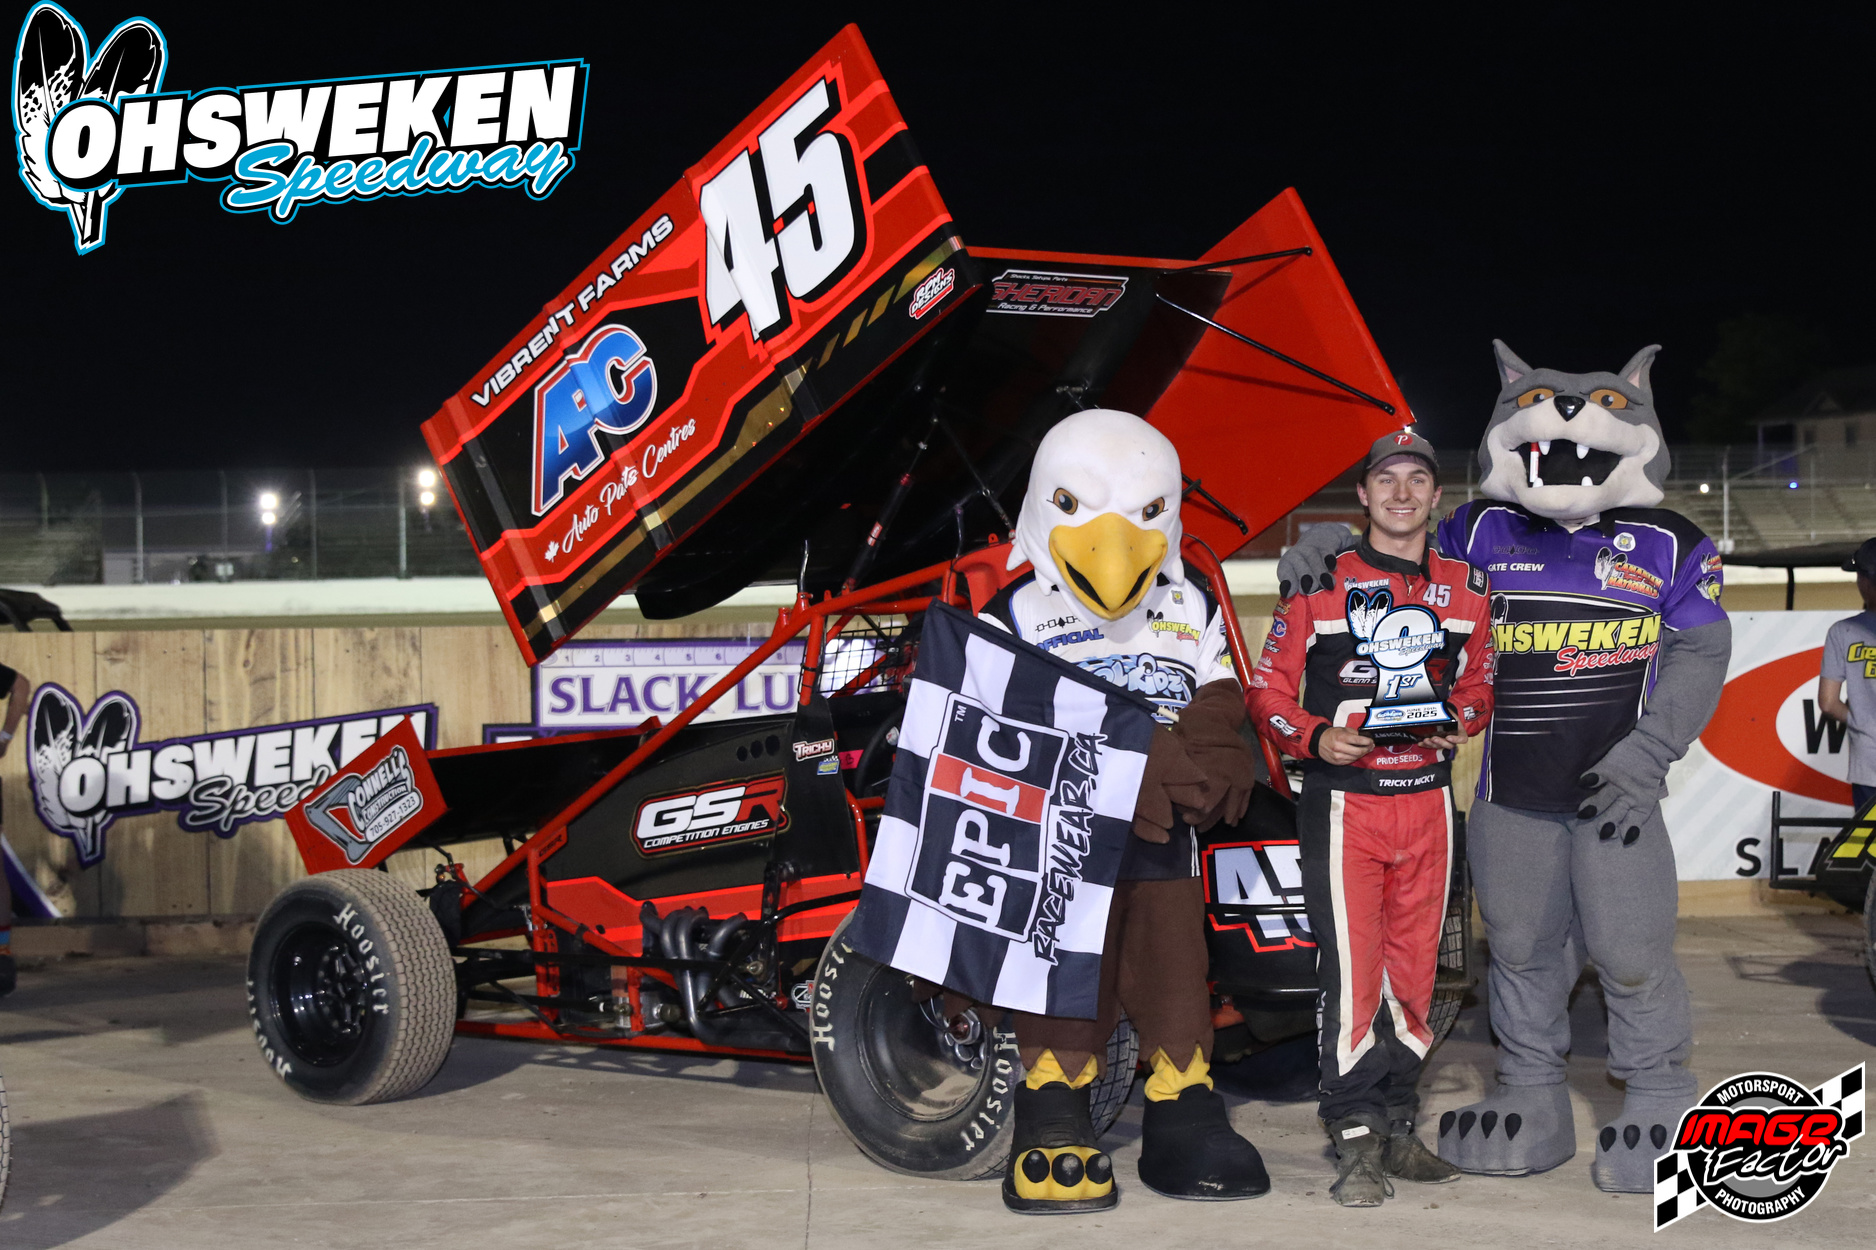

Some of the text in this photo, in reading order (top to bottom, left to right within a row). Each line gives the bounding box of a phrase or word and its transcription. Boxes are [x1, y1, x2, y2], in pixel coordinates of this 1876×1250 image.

[700, 78, 856, 339] 45
[911, 272, 953, 314] DESIGNS
[916, 271, 942, 302] RPM
[992, 282, 1122, 306] SHERIDAN
[472, 215, 674, 406] VIBRENT FARMS
[998, 303, 1027, 311] Racing
[1038, 305, 1093, 313] Performance
[562, 504, 600, 553] Auto
[642, 418, 697, 478] Centres
[1510, 563, 1545, 571] CREW
[1423, 583, 1452, 608] 45
[1359, 632, 1444, 654] OHSWEKEN
[1399, 641, 1445, 656] Speedway
[594, 654, 600, 663] 2
[625, 654, 631, 662] 3
[655, 653, 661, 661] 4
[1554, 641, 1660, 676] Speedway
[548, 672, 714, 715] SLACK
[1385, 674, 1423, 699] 1ST
[954, 705, 967, 723] TM
[1407, 710, 1438, 719] 2025
[1377, 754, 1423, 765] PRIDE SEEDS
[1379, 778, 1414, 787] TRICKY
[362, 784, 407, 823] CONSTRUCTION
[370, 796, 416, 837] 705-927-1323
[636, 778, 785, 839] GSR
[644, 819, 769, 848] COMPETITION ENGINES
[938, 715, 1032, 928] EPIC
[1032, 731, 1108, 967] RACEWEAR.CA
